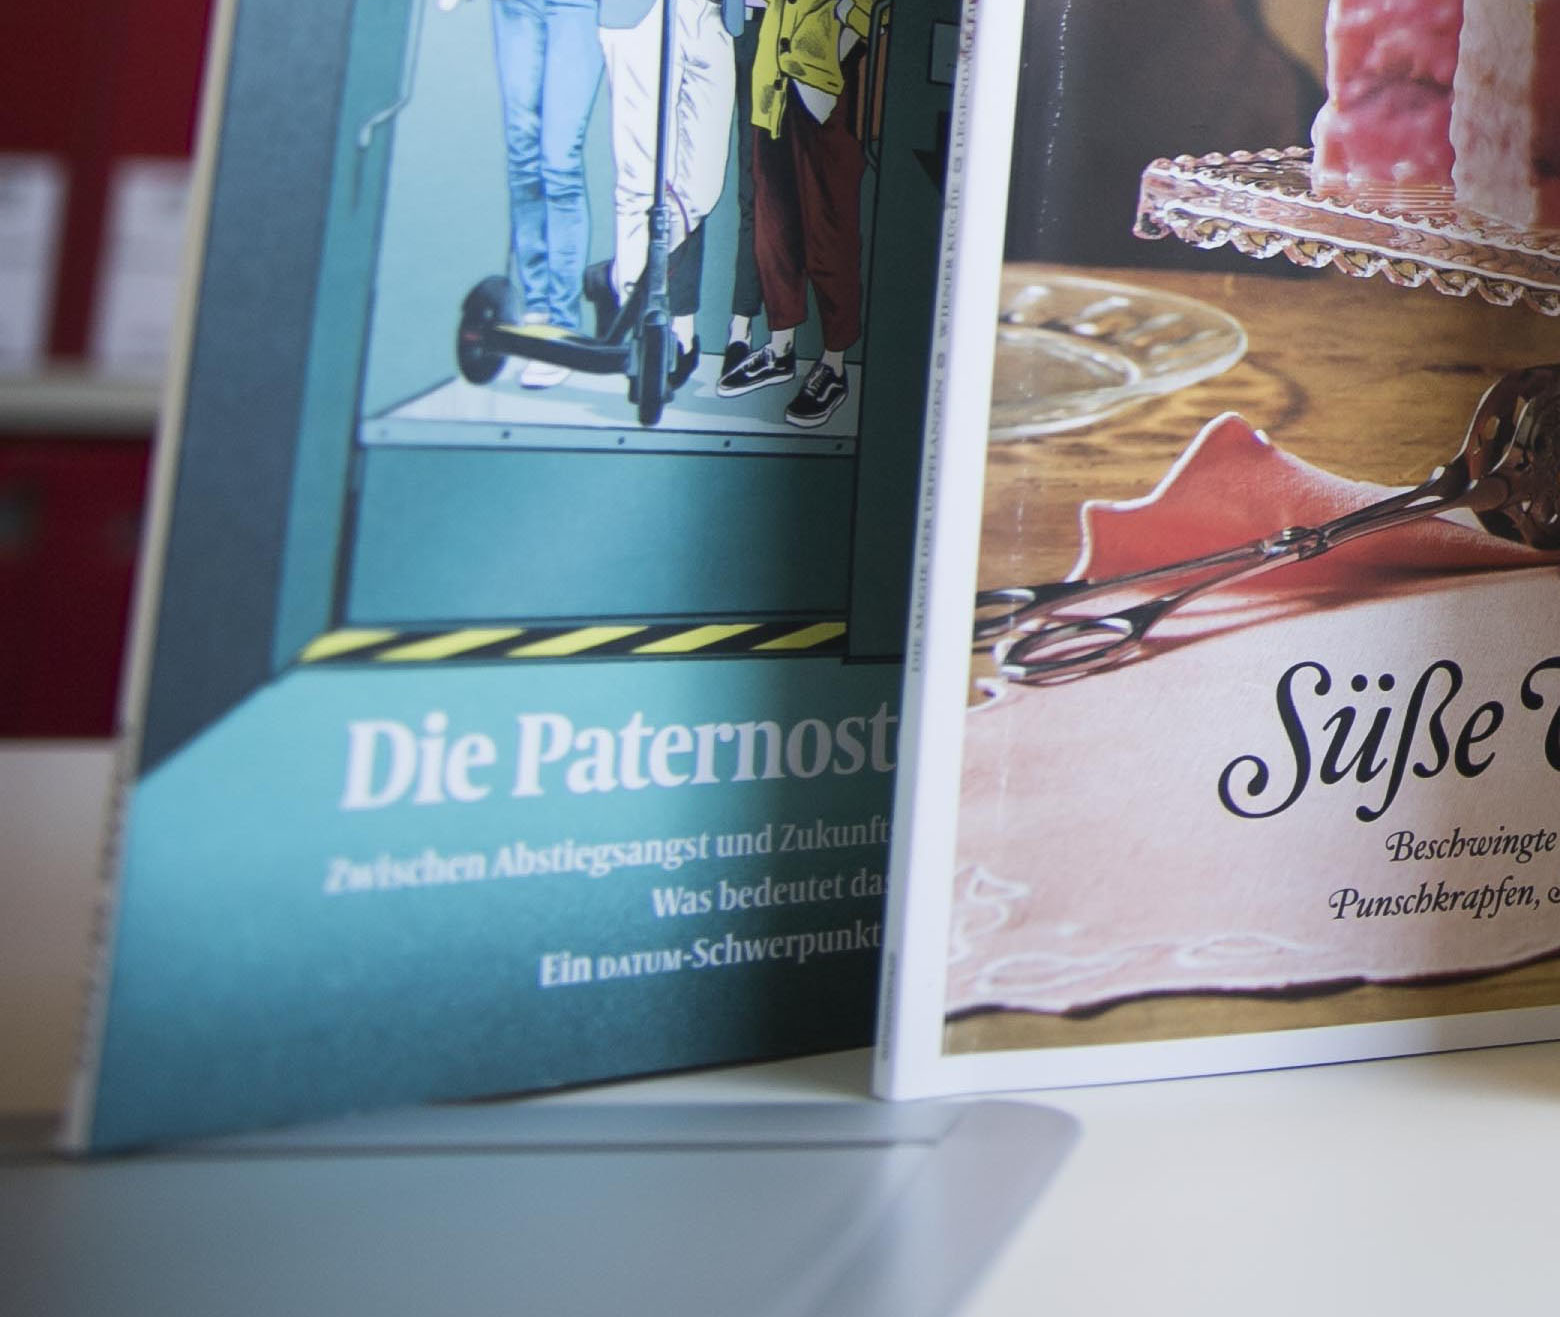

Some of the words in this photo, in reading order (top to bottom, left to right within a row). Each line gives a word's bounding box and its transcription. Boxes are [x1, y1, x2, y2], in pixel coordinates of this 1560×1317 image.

[339, 711, 498, 810] Die
[512, 701, 898, 797] Paternost
[1218, 659, 1504, 822] Süße
[324, 848, 487, 894] Zwischen
[493, 830, 709, 878] Abstiegsangst
[715, 824, 773, 856] und
[1385, 827, 1557, 863] Beschwingte
[652, 887, 713, 919] Was
[719, 872, 843, 910] bedeutet
[1329, 877, 1540, 920] Punschkrapfen,
[541, 953, 592, 988] Ein
